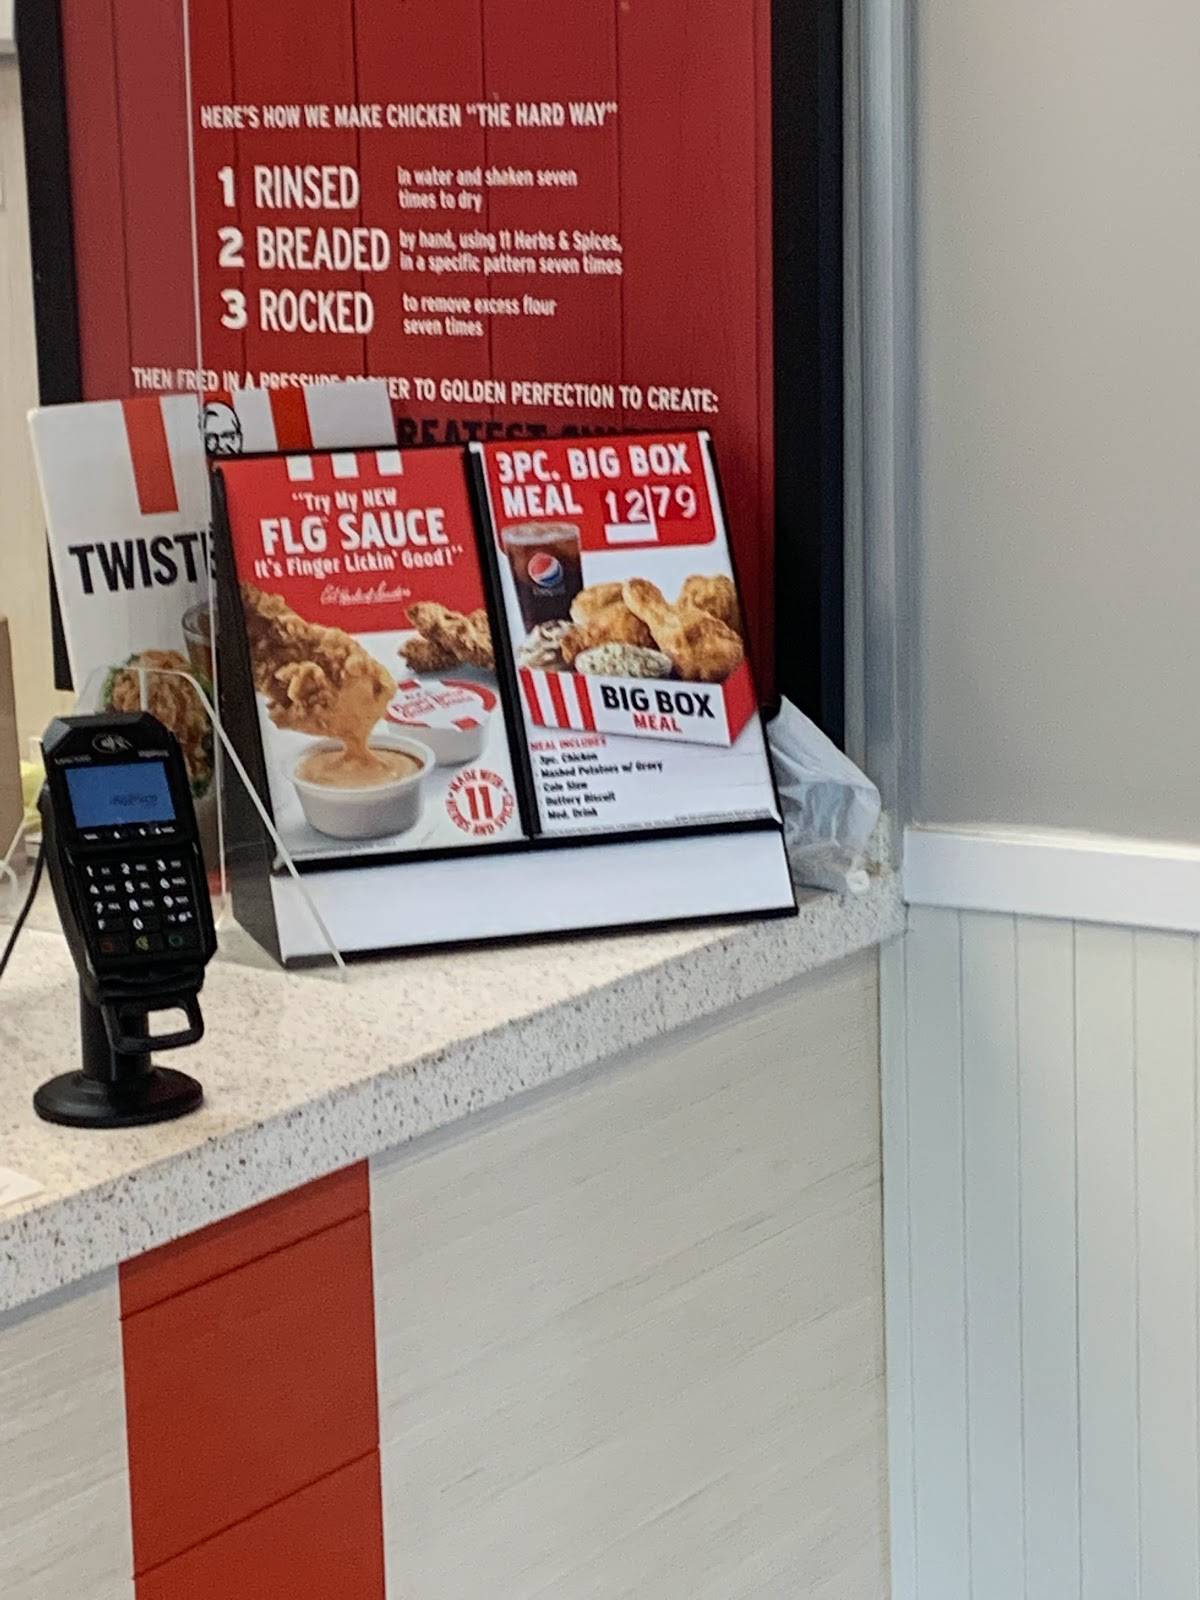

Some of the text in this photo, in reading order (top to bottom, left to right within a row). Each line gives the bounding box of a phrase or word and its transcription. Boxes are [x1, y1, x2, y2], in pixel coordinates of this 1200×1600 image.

[200, 101, 619, 129] HERE'S HOW WE MAKE CHICKEN "THE HARD WAY"
[217, 164, 361, 210] 1 RINSED
[413, 165, 454, 187] water
[456, 166, 482, 187] and
[484, 165, 535, 188] shaken
[536, 169, 579, 188] seven
[398, 187, 483, 214] times to dry
[217, 225, 392, 272] 2 BREADED
[398, 228, 417, 253] by
[459, 228, 497, 254] using
[514, 229, 557, 252] Herbs
[558, 229, 570, 252] &
[415, 253, 427, 273] a
[427, 251, 481, 276] specific
[483, 251, 538, 277] pattern
[538, 256, 581, 275] seven
[581, 252, 624, 277] times
[219, 287, 376, 335] 3 ROCKED
[402, 293, 558, 318] to remove excess flour
[402, 315, 485, 338] seven times
[131, 366, 173, 390] THEN
[222, 369, 240, 393] IN
[243, 370, 256, 392] A
[413, 377, 436, 401] TO
[439, 378, 506, 404] GOLDEN
[510, 380, 615, 410] PERFECTION
[618, 384, 643, 411] TO
[645, 386, 719, 415] CREATE:
[495, 442, 692, 485] 3PC. BIG BOX
[334, 489, 359, 514] My
[361, 486, 398, 508] NEW
[500, 482, 585, 519] MEAL
[259, 507, 450, 556] FLG SAUCE
[253, 557, 283, 579] It's
[286, 556, 341, 580] Finger
[344, 550, 399, 573] Lickin'
[599, 684, 717, 721] BIG BOX
[632, 712, 684, 734] MEAL
[540, 767, 576, 779] Mashed
[577, 764, 619, 777] Potatoes
[635, 759, 664, 773] Gravy
[561, 752, 598, 764] Chicken
[543, 780, 589, 793] Cole Slaw
[545, 790, 617, 807] Buttery Biscuit
[464, 785, 494, 820] 11
[571, 806, 599, 819] Drink
